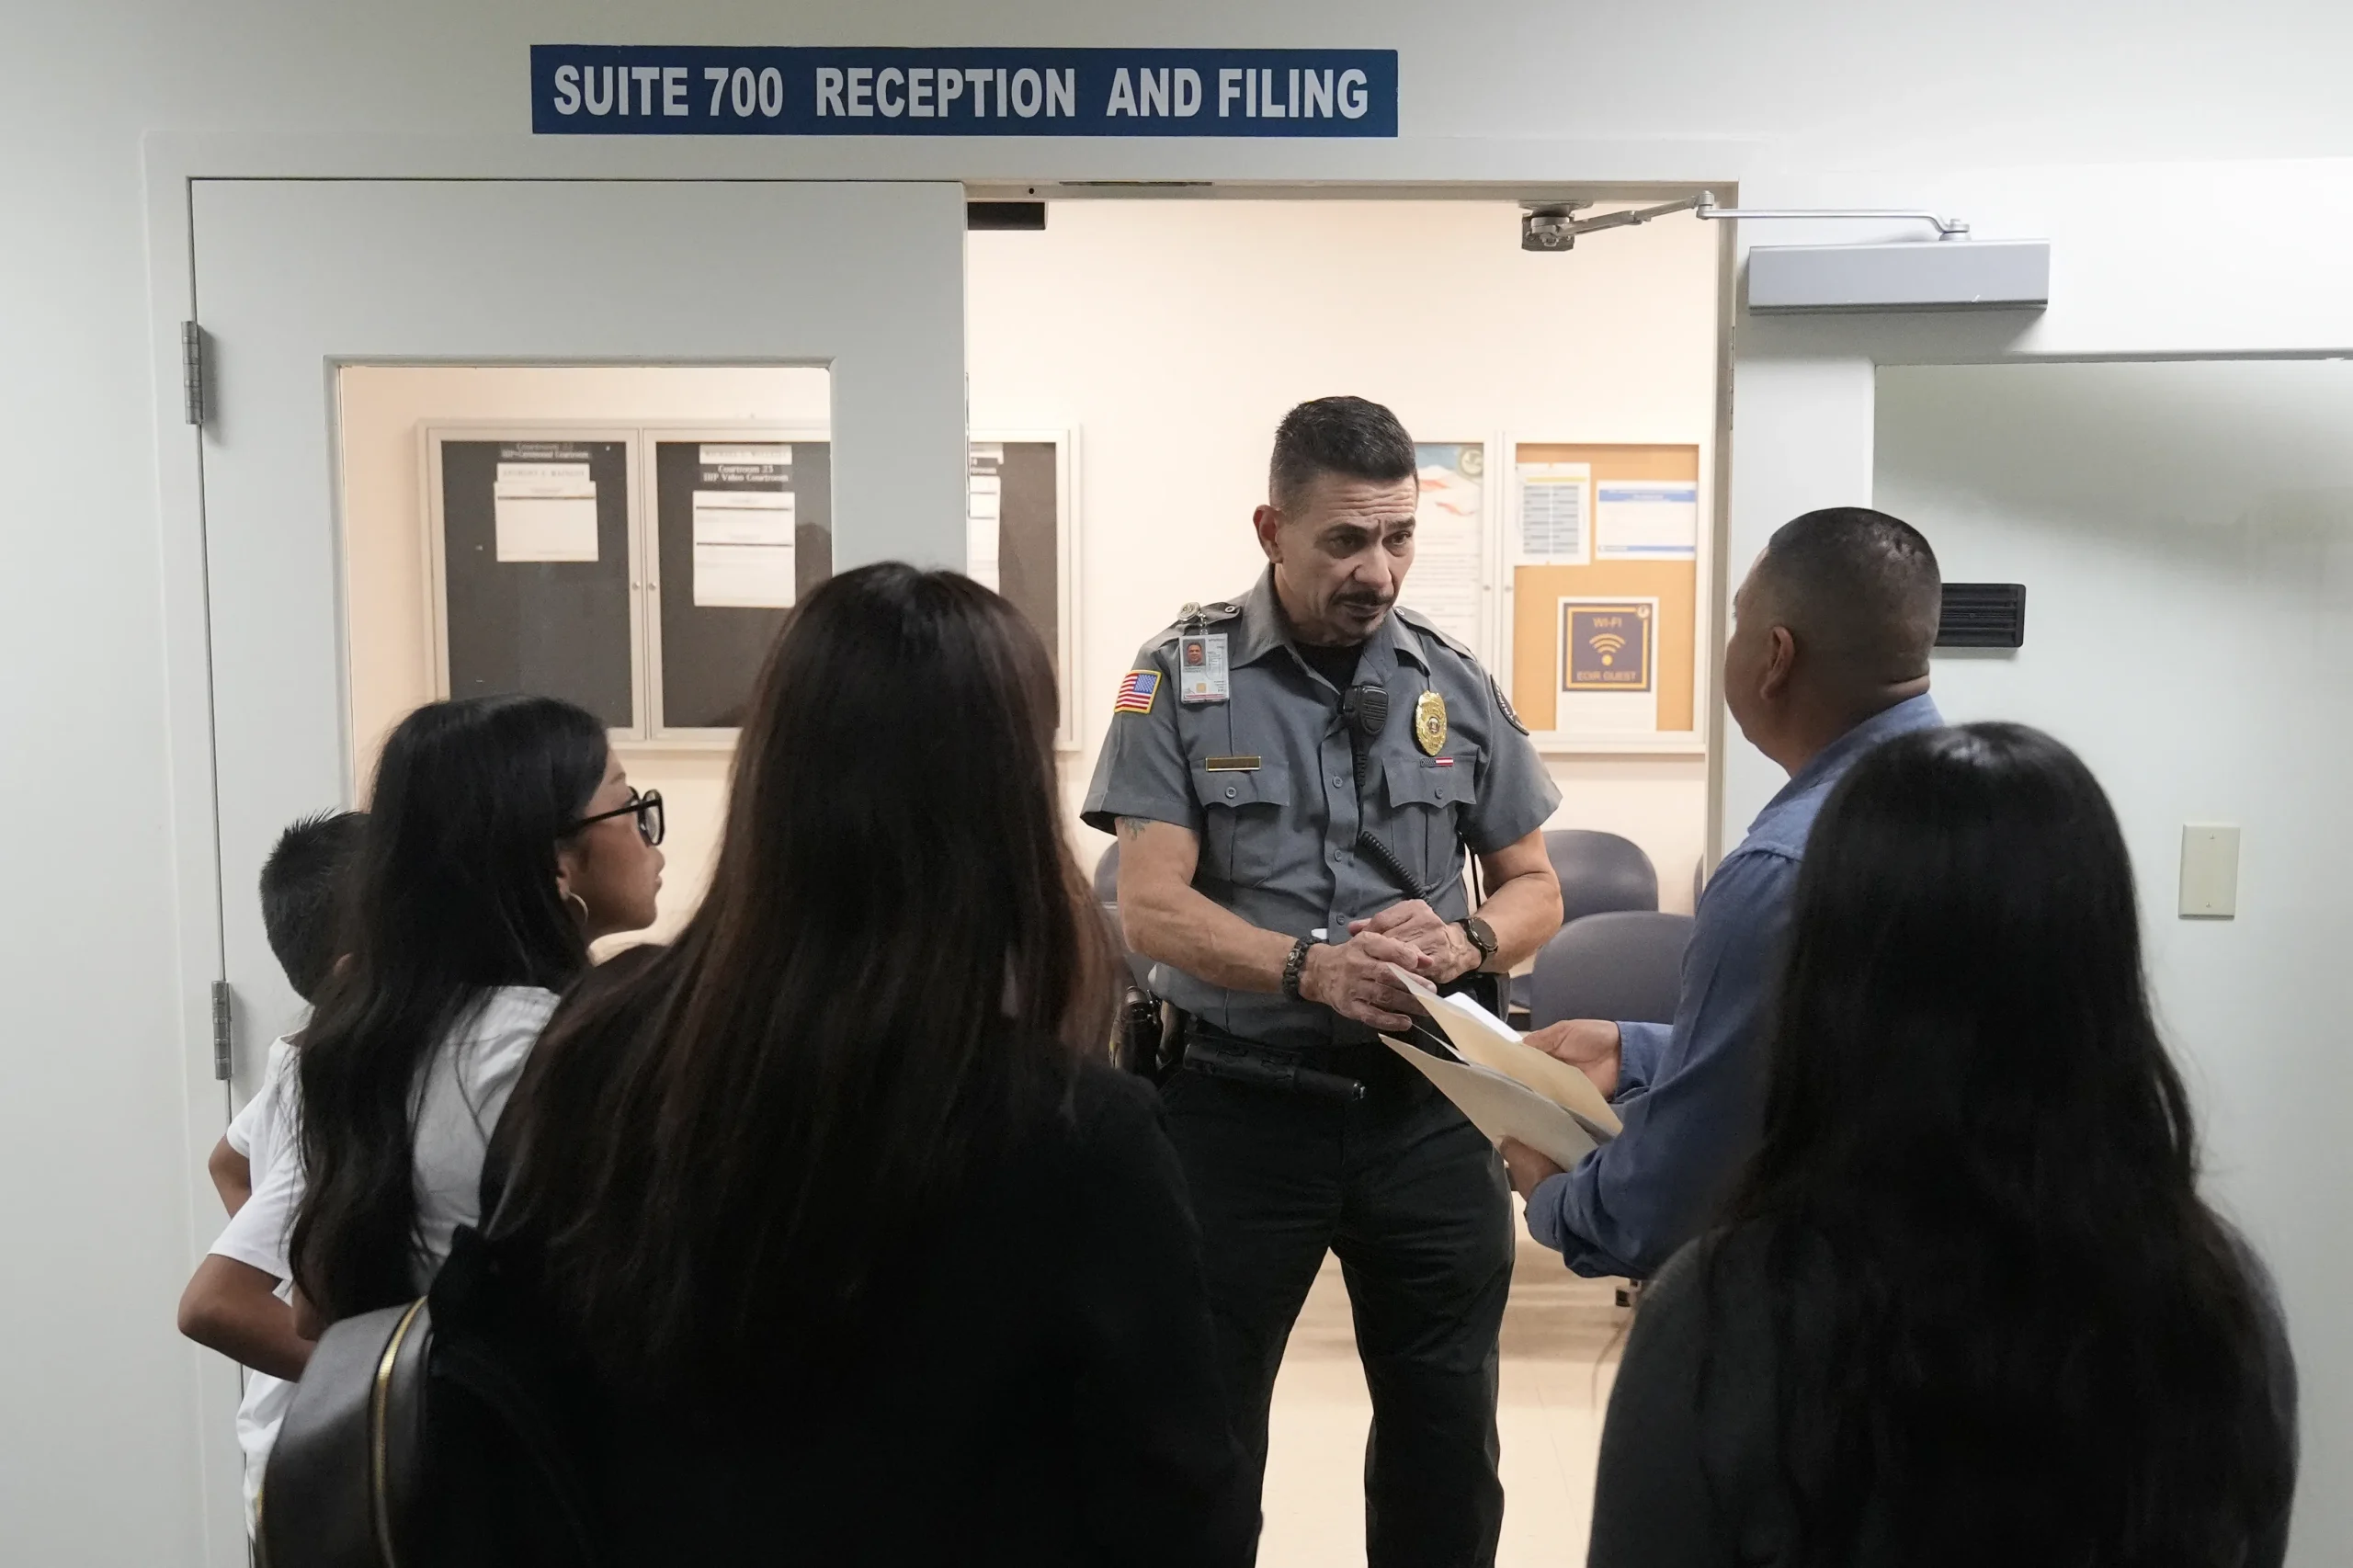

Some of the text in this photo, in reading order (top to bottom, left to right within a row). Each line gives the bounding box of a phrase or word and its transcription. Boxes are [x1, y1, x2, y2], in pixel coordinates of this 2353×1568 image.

[554, 65, 1367, 119] SUITE 700 RECEPTION AND FILING
[1592, 617, 1622, 628] WI-FI
[1603, 671, 1637, 681] GUEST
